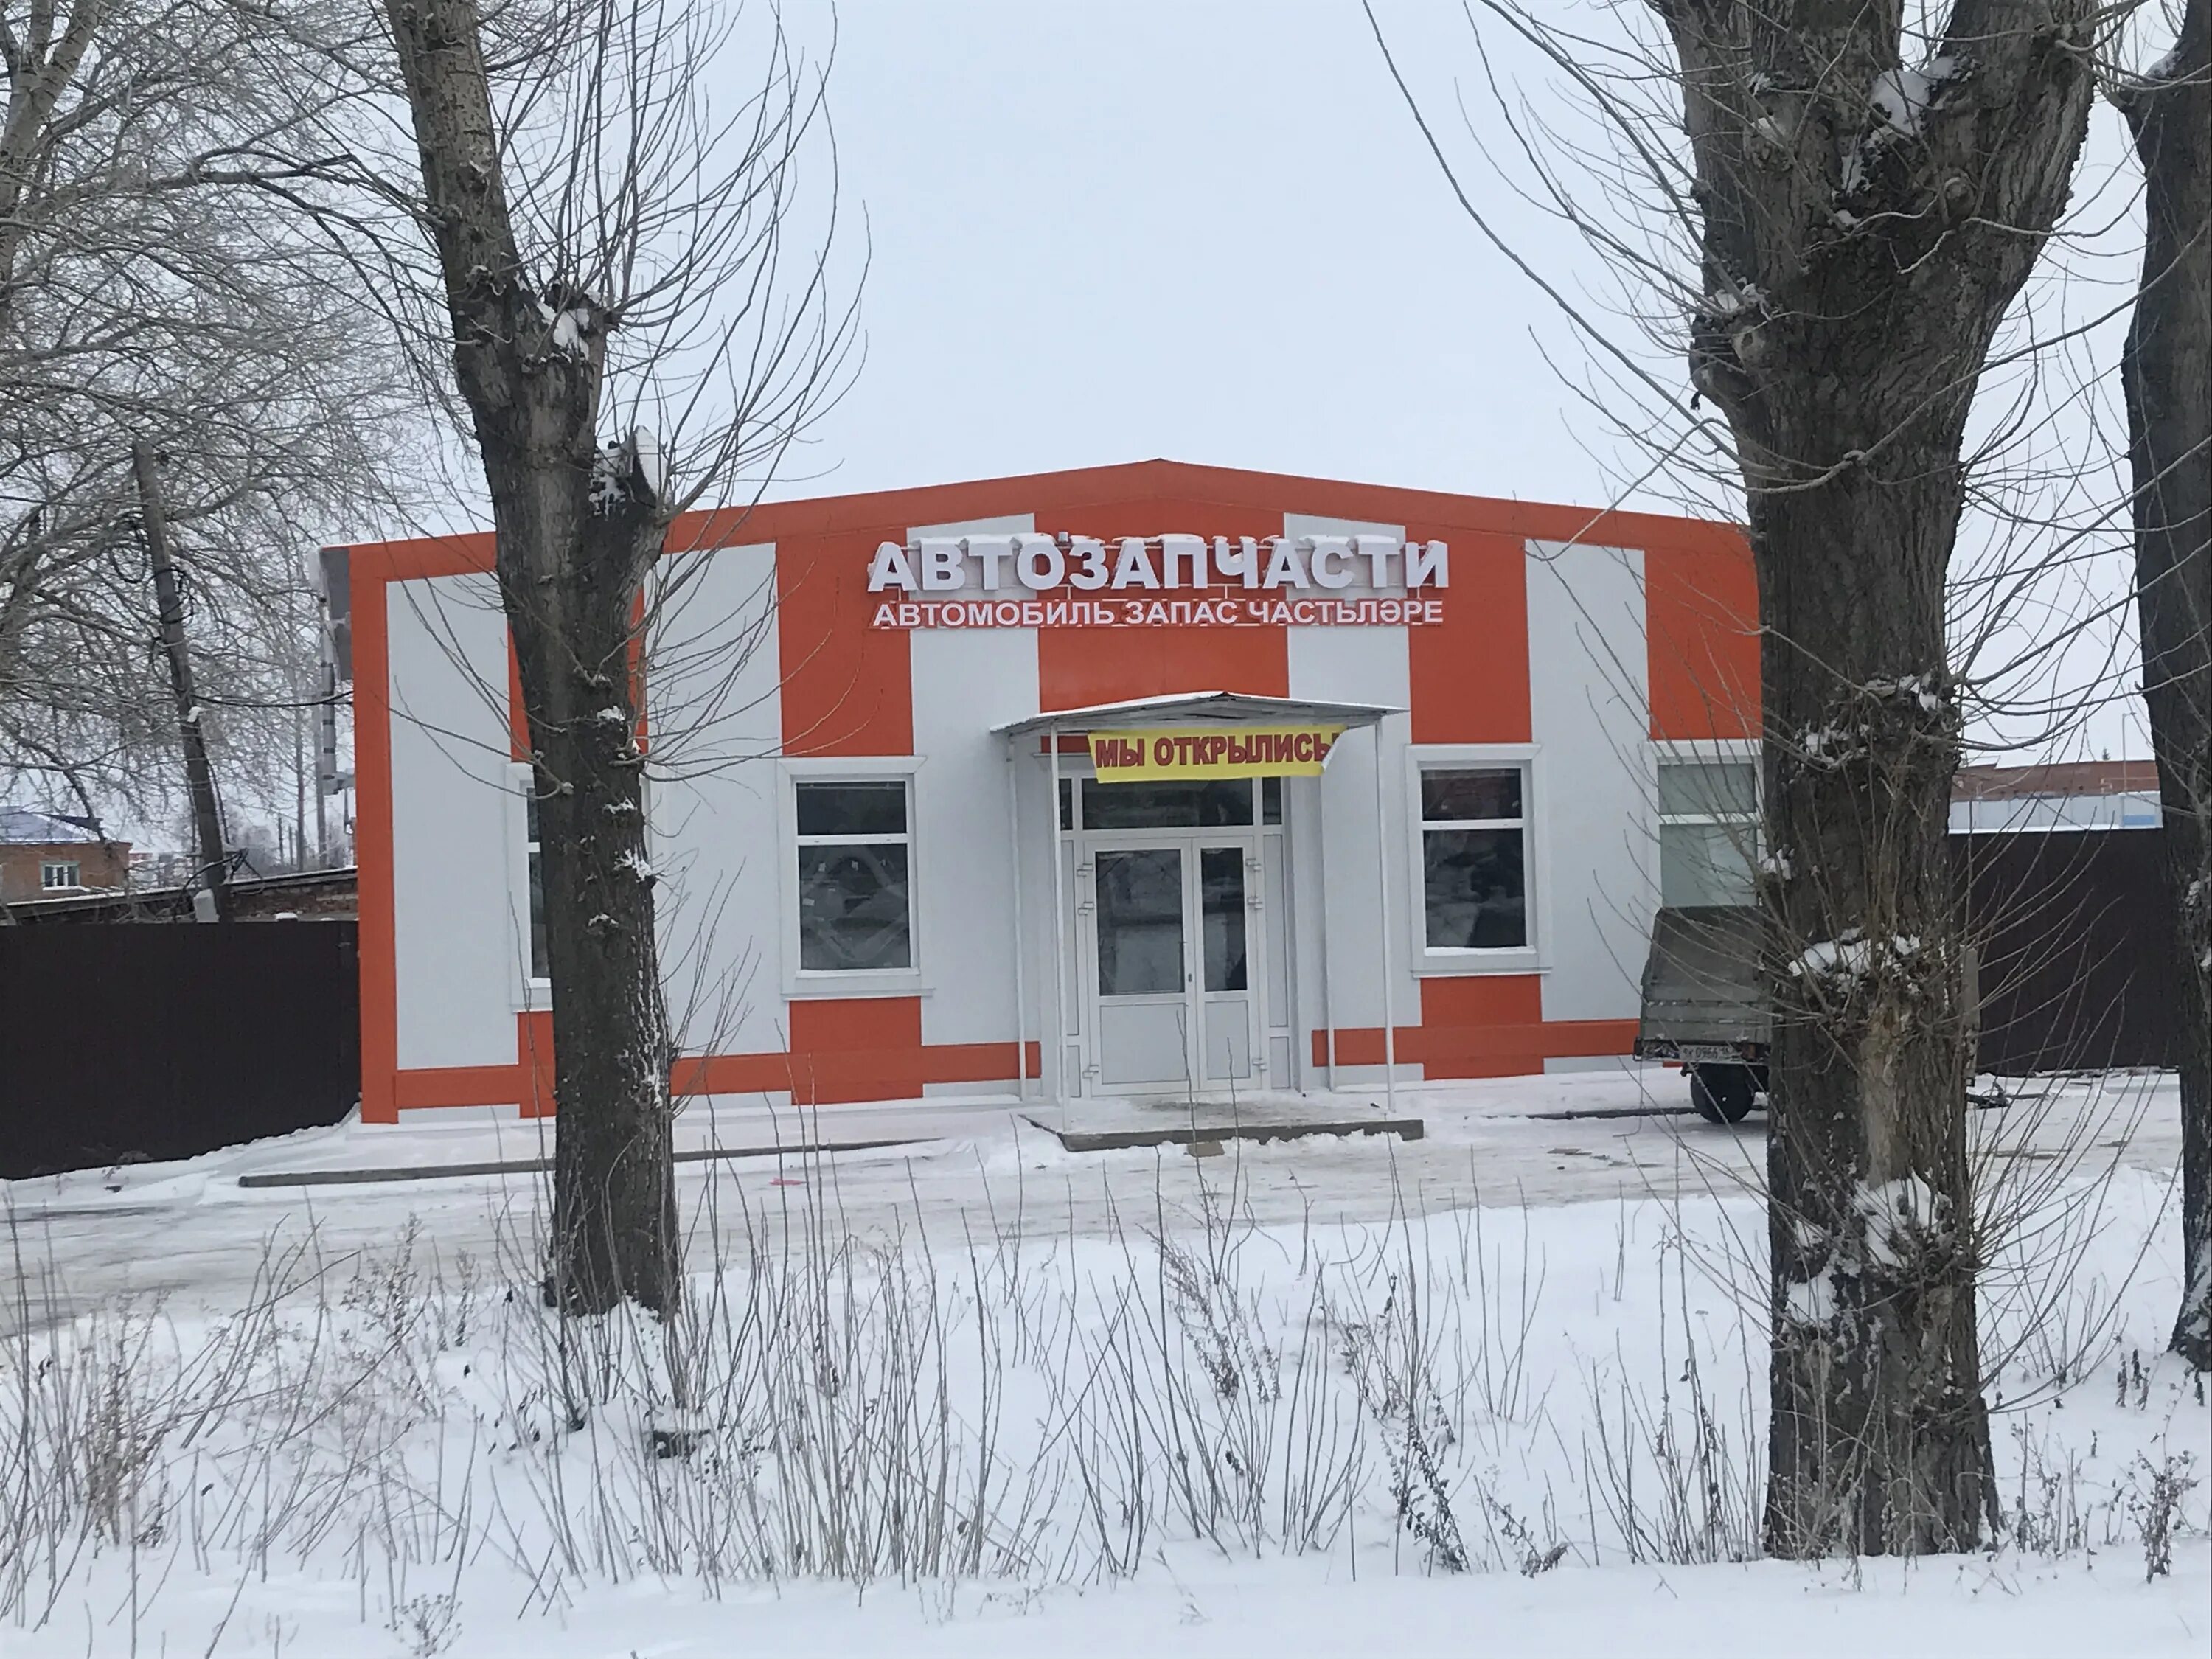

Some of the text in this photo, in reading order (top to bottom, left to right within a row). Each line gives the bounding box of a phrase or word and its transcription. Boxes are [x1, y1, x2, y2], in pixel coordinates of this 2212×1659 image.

[867, 539, 1449, 591] АВТОЗАПЧАСТИ
[872, 600, 1444, 627] АВТОМОБИЛЬ ЗАПАС ЧАСТЬЛӘРЕ
[1095, 732, 1340, 768] МЫ ОТКРЫЛИСЬ
